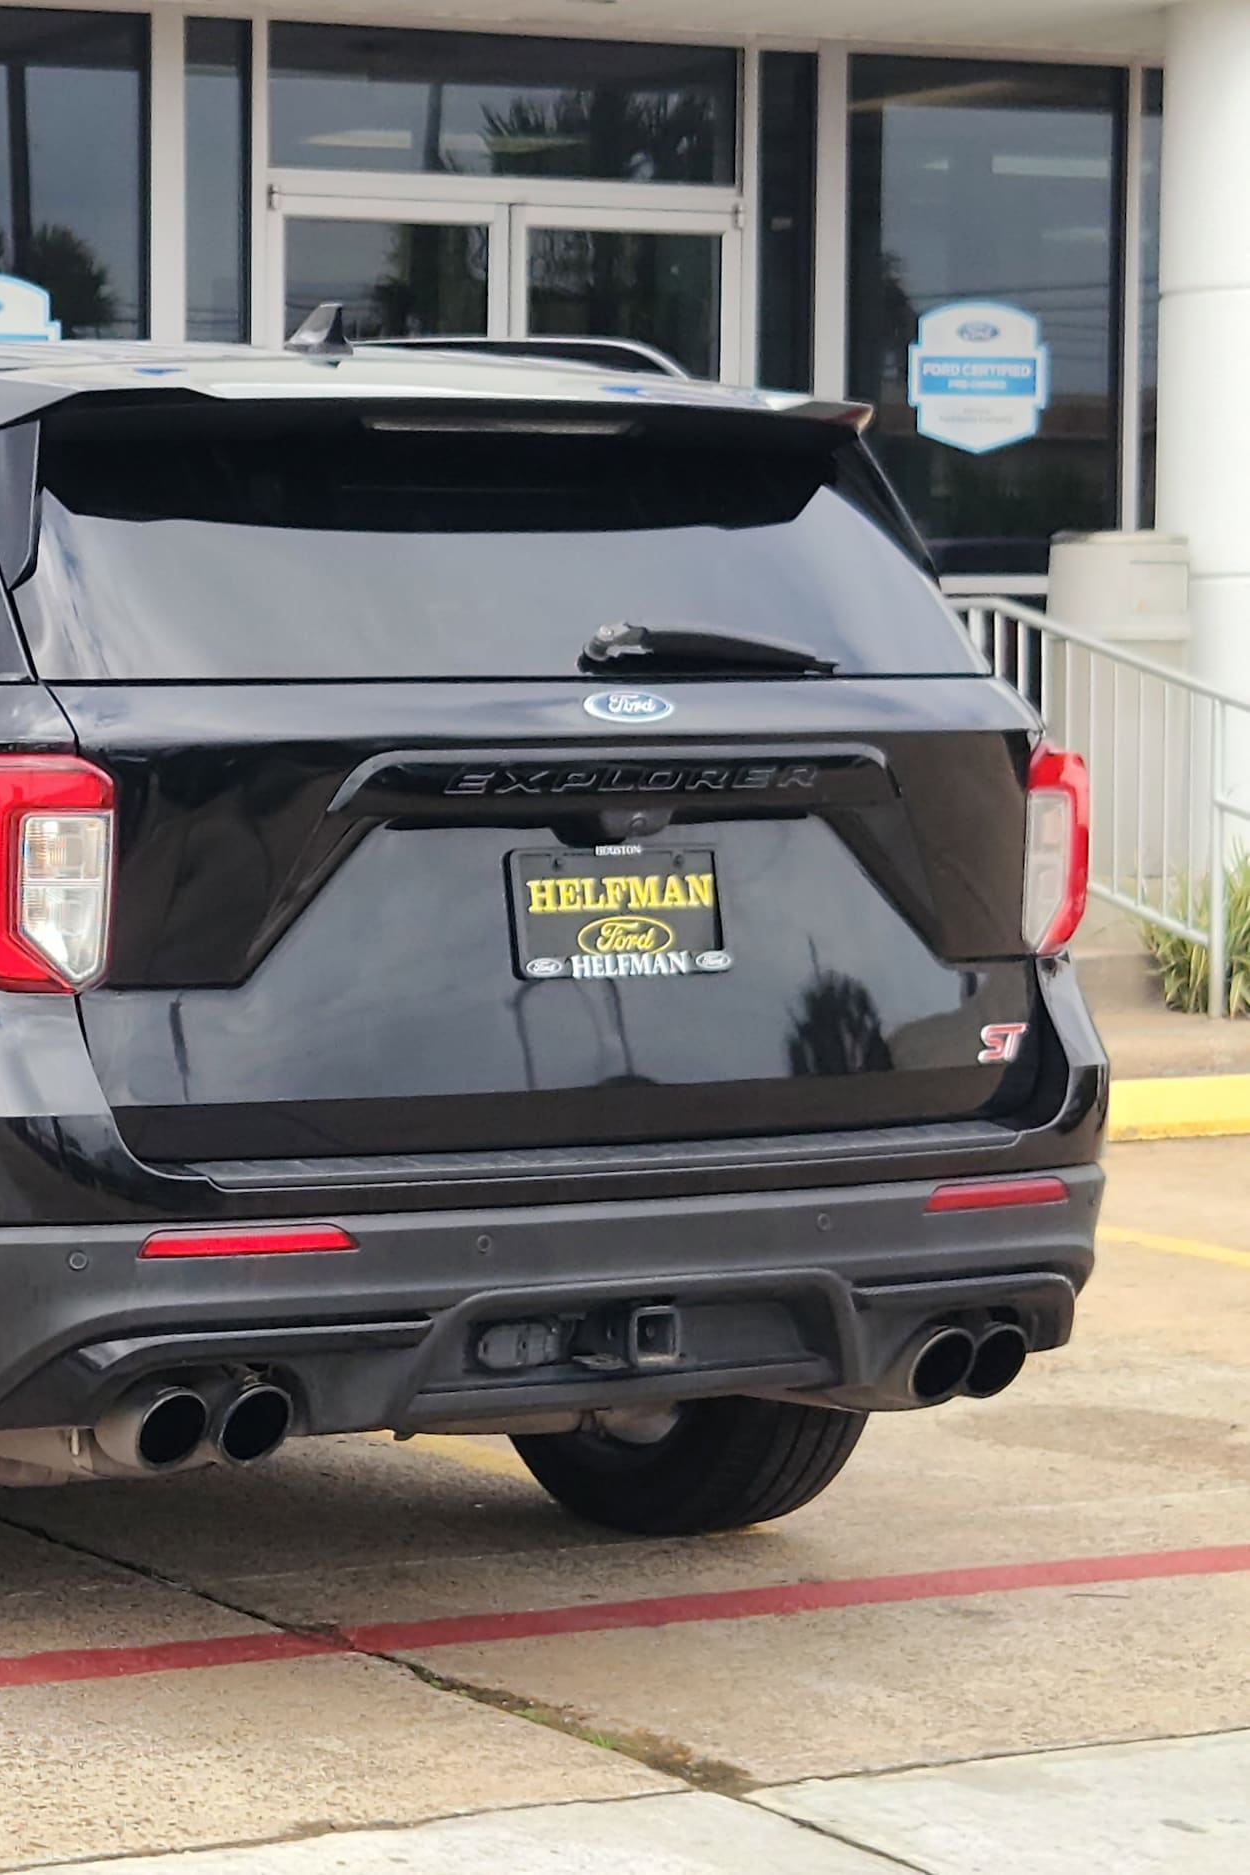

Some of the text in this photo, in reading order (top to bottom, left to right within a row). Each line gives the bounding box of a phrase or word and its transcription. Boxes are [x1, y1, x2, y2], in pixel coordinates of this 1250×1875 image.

[606, 693, 657, 715] Ford
[443, 764, 820, 795] EXPLORER
[594, 844, 643, 857] HOUSTON
[525, 872, 715, 914] HELFMAN
[595, 920, 656, 953] Ford
[571, 949, 690, 980] HELFMAN
[977, 1022, 1029, 1064] ST
